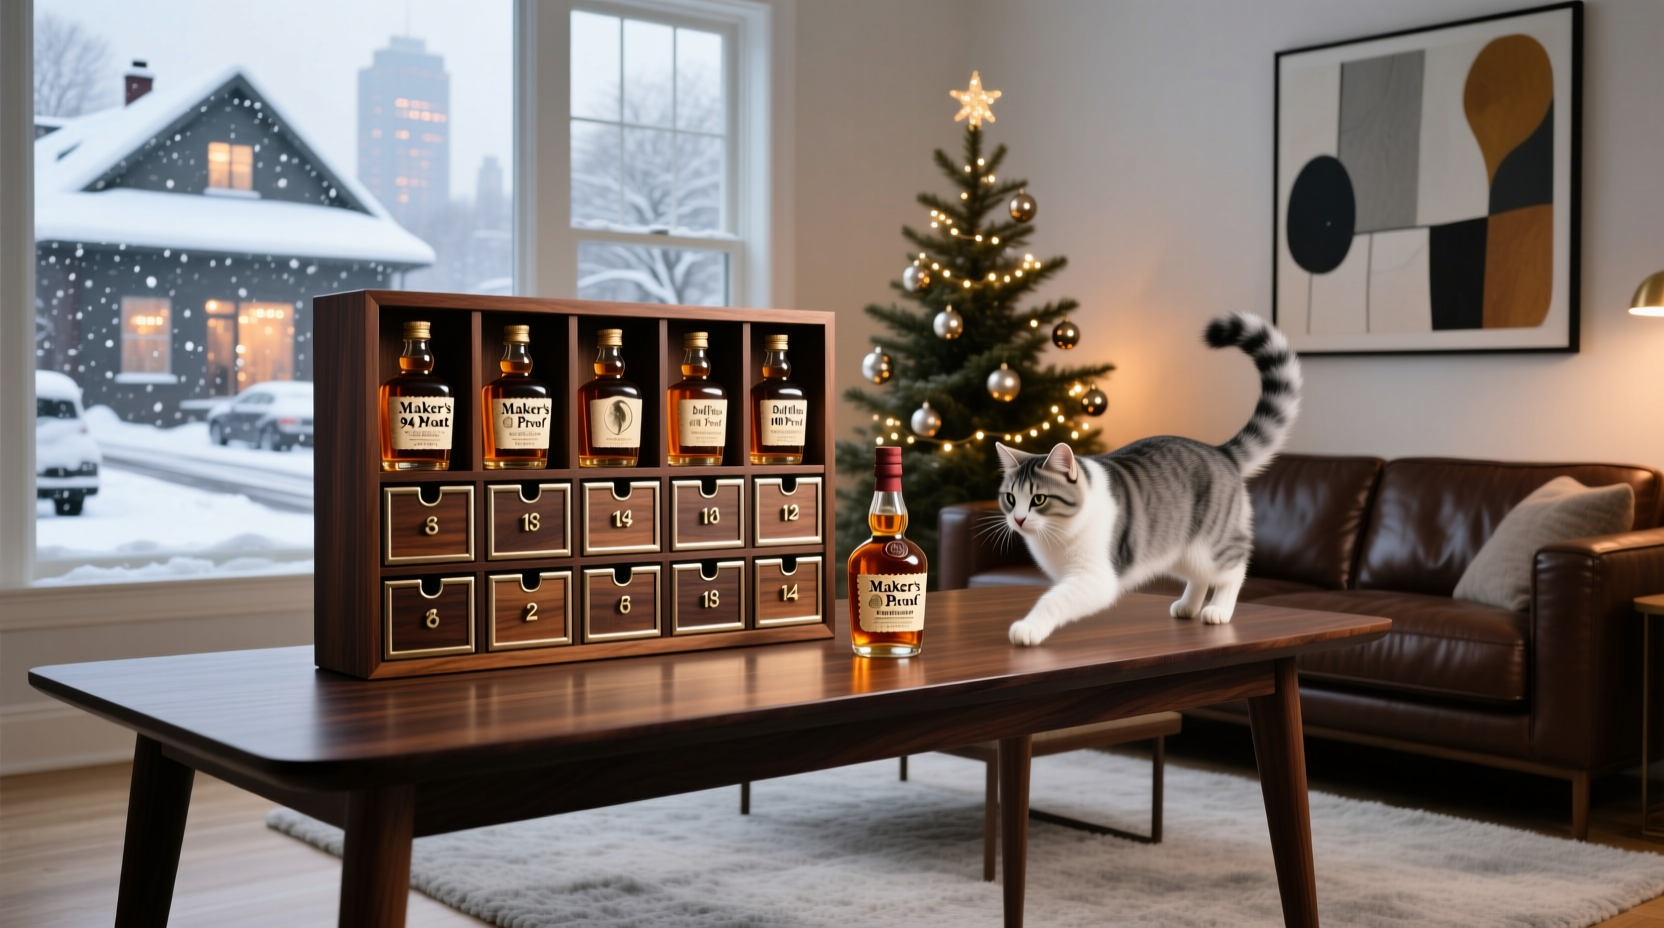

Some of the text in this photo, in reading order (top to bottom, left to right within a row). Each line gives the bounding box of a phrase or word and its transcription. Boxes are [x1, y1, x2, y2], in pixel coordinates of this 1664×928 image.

[399, 401, 451, 414] Maker's
[501, 402, 549, 415] Maker's
[782, 504, 799, 521] 12
[781, 584, 799, 601] 14
[869, 580, 921, 592] Maker's
[526, 602, 538, 621] 2
